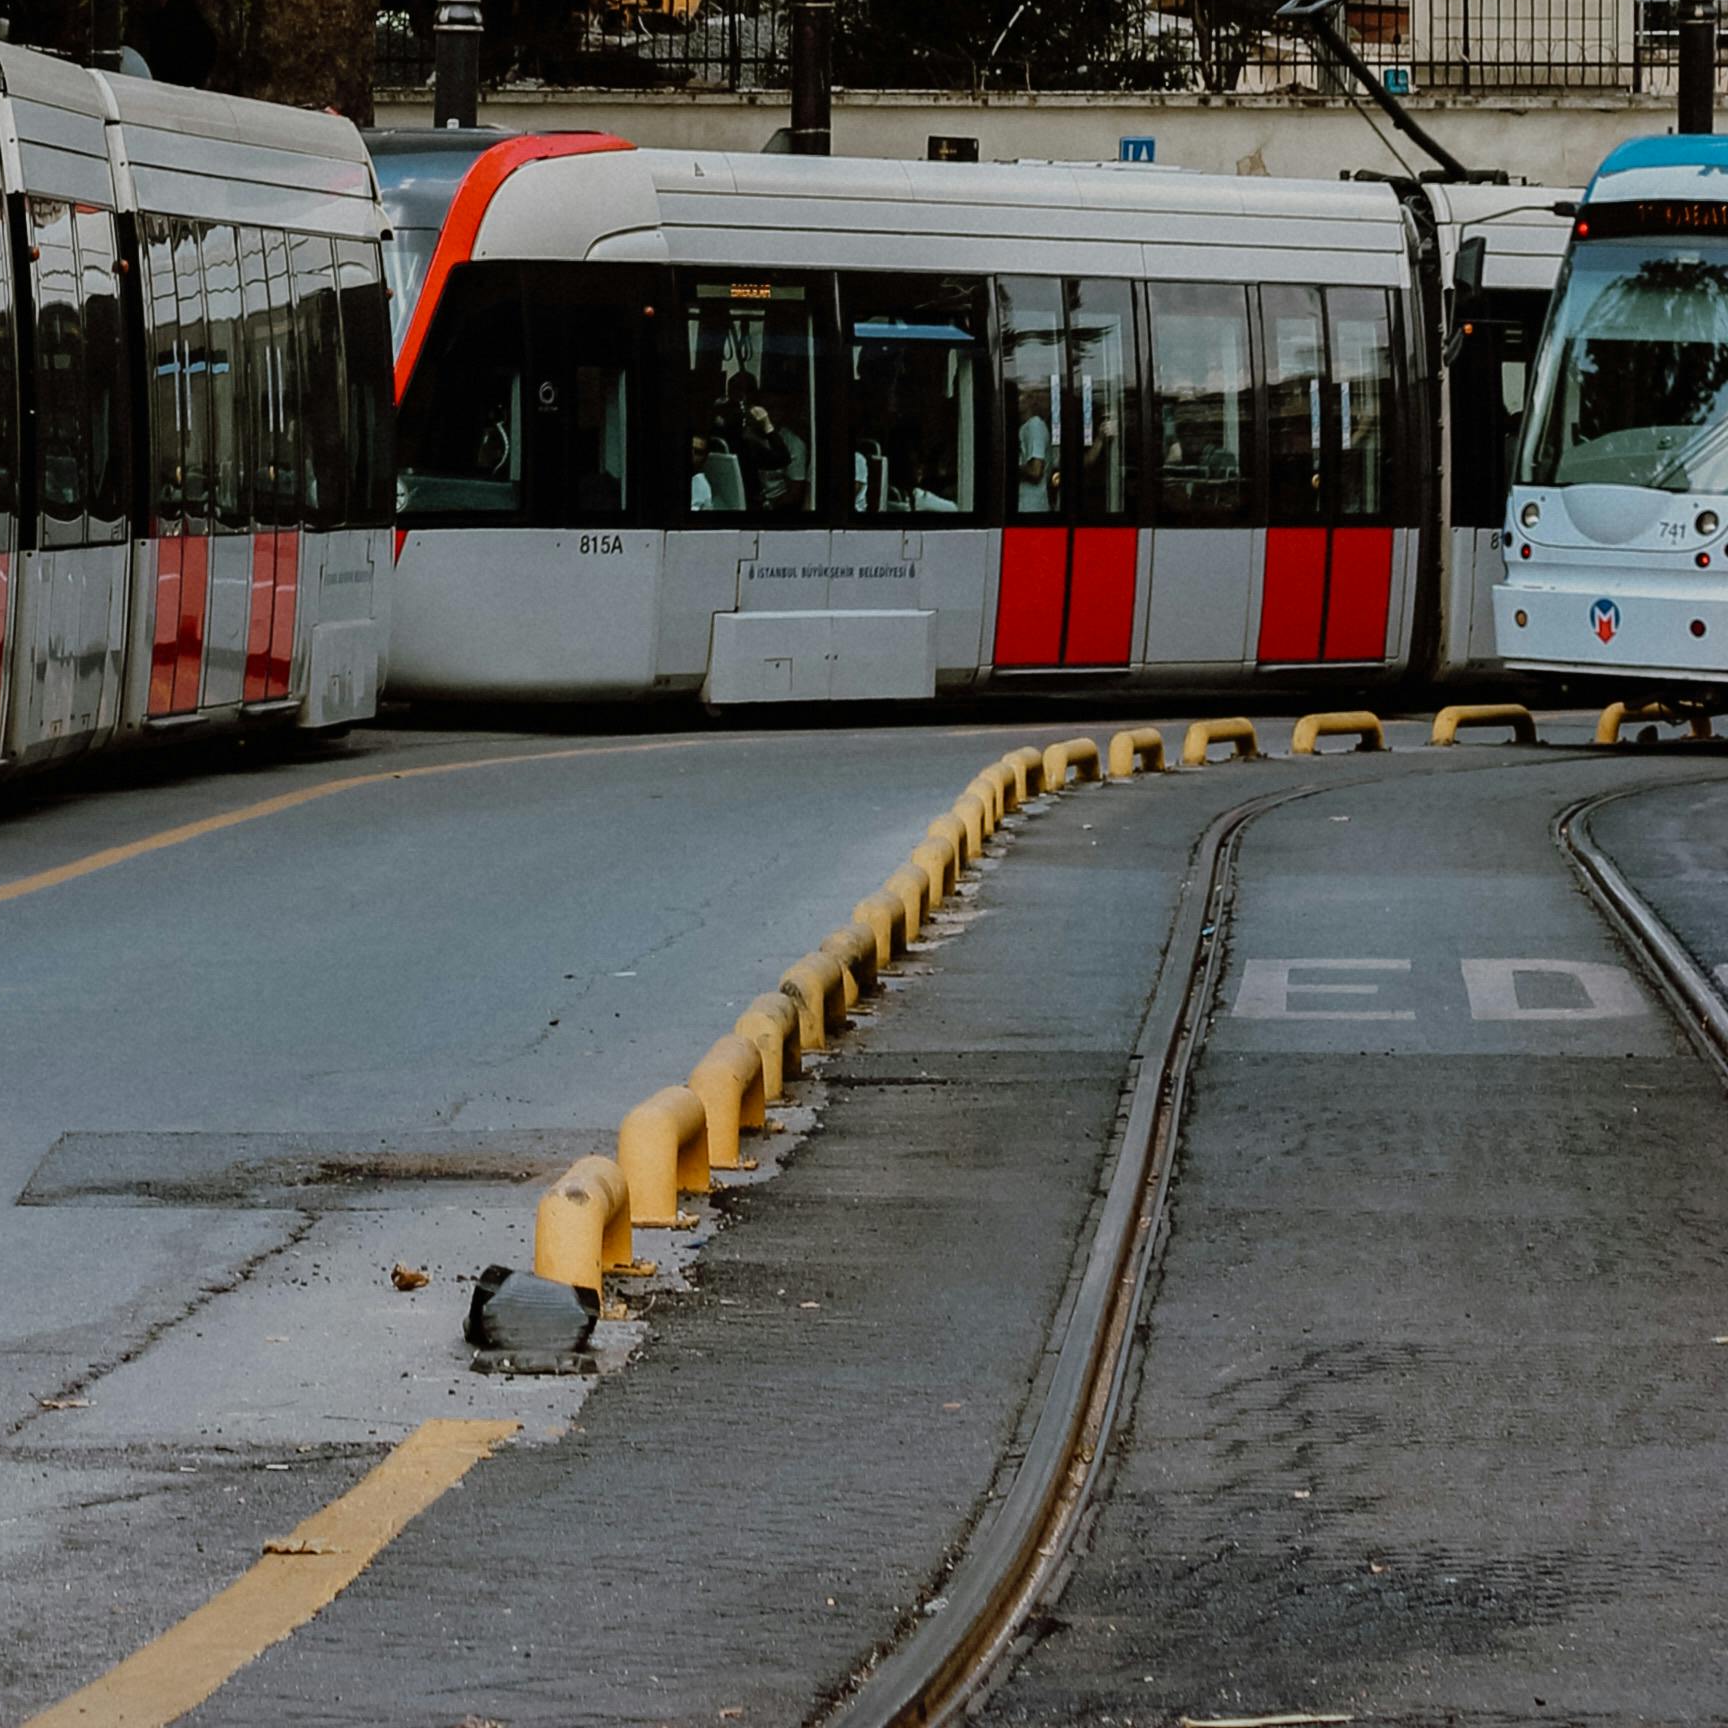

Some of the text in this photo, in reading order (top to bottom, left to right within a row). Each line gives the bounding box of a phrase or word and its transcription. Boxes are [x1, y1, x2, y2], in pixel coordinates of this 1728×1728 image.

[1659, 522, 1685, 538] 741
[580, 535, 622, 554] 815A
[757, 566, 797, 578] İSTANBUL
